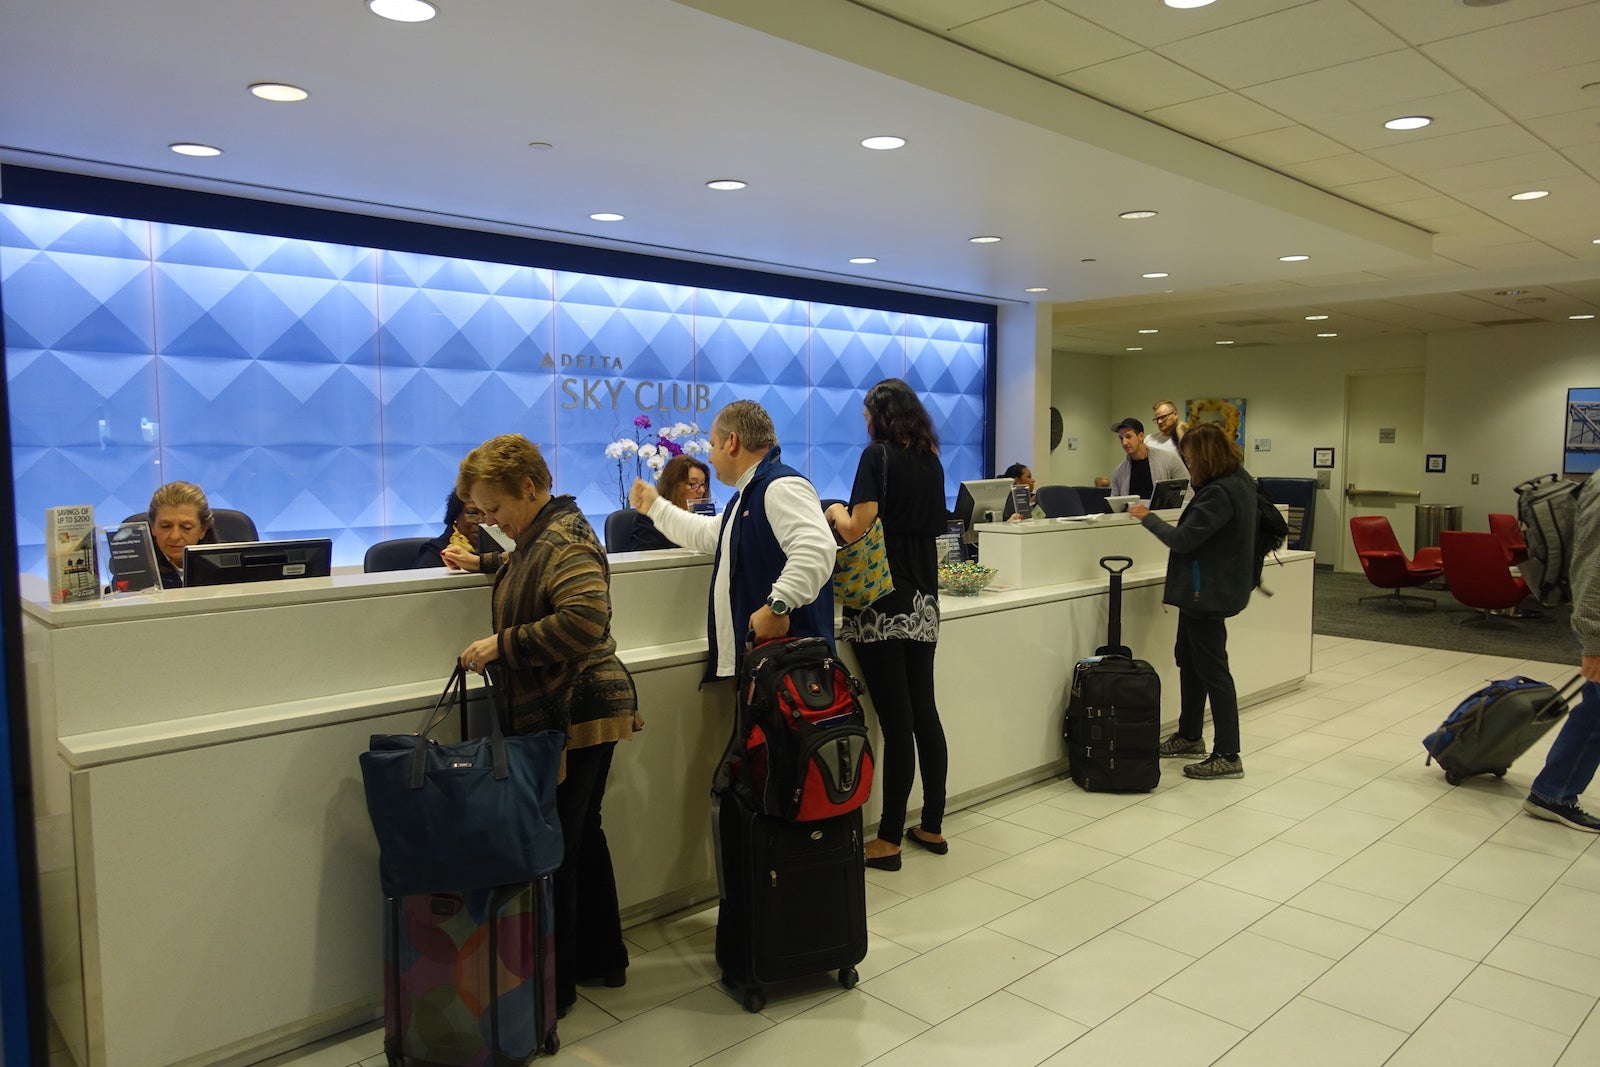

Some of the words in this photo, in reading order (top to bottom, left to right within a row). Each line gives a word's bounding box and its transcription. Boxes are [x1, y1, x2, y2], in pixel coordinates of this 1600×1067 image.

[561, 353, 623, 369] DELTA
[561, 378, 625, 410] SKY
[634, 381, 711, 412] CLUB
[74, 515, 90, 523] $200
